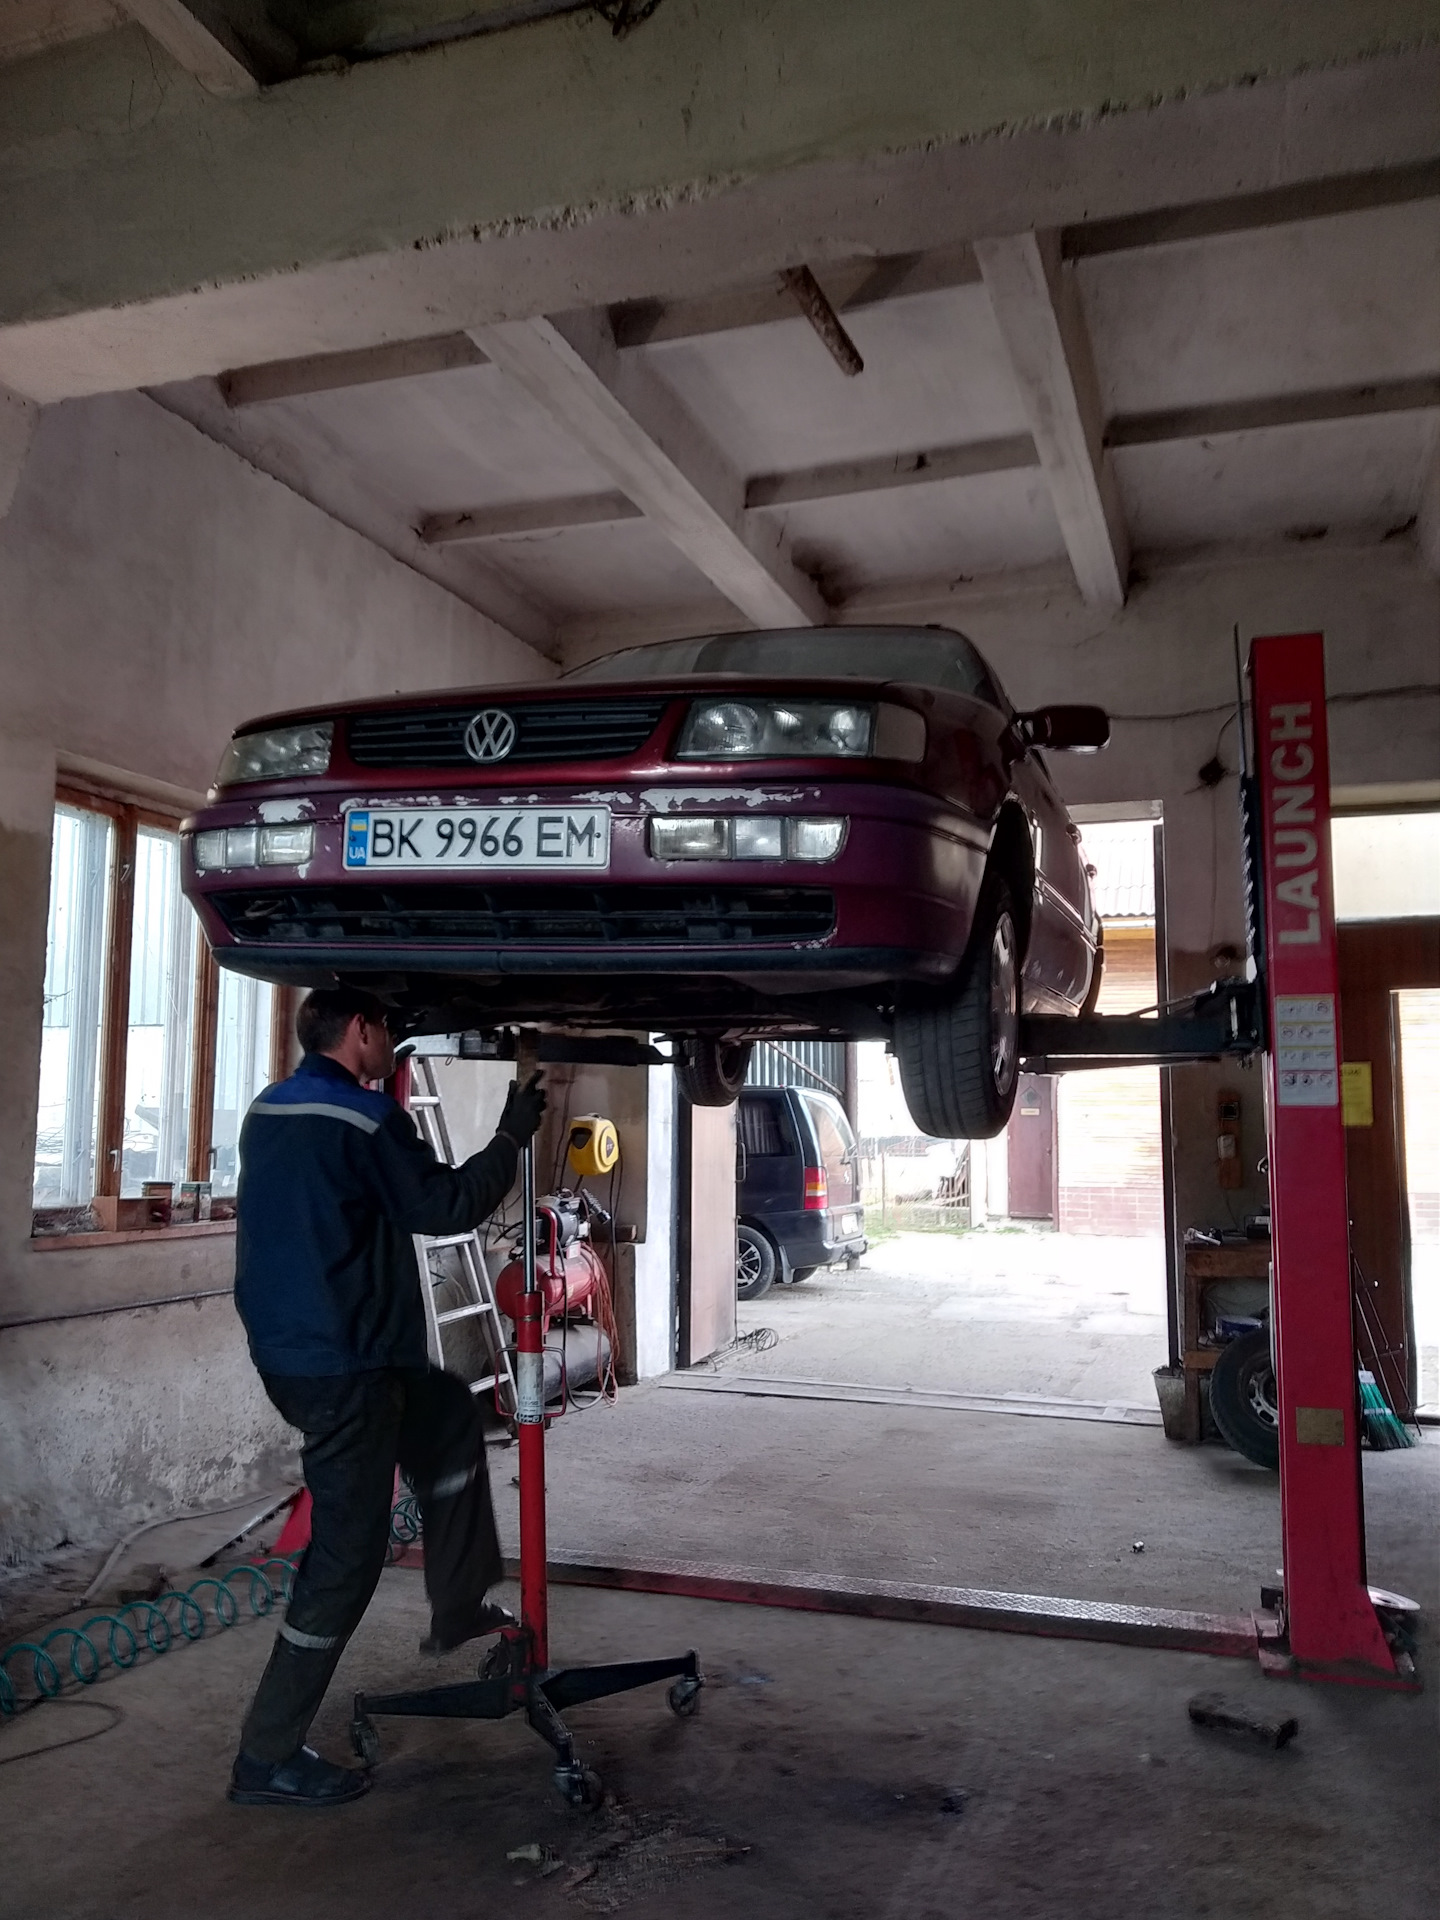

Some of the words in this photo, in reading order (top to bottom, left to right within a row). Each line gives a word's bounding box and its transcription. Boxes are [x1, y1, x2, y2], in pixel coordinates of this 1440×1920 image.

[465, 709, 515, 762] VW
[372, 819, 423, 857] BK
[435, 817, 523, 857] 9966
[536, 816, 595, 857] EM
[1270, 702, 1321, 944] LAUNCH
[349, 846, 366, 859] UA
